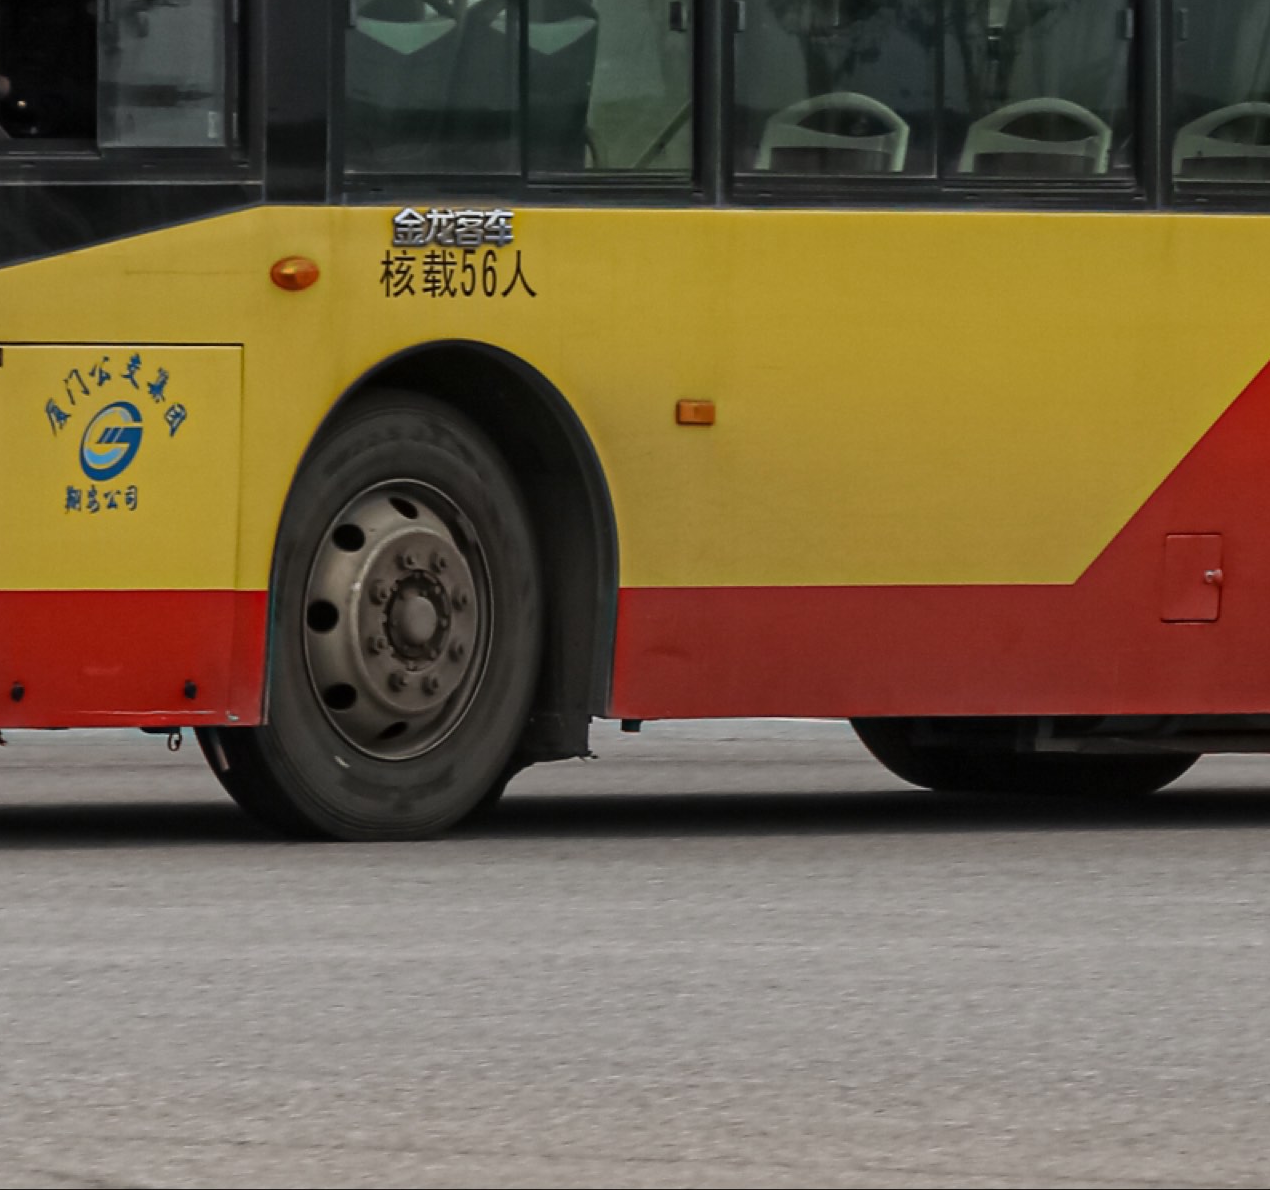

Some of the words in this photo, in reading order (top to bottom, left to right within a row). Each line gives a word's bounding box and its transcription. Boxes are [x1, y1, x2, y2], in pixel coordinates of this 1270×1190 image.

[392, 207, 515, 248] 金龙客车
[379, 249, 537, 298] 核载56人
